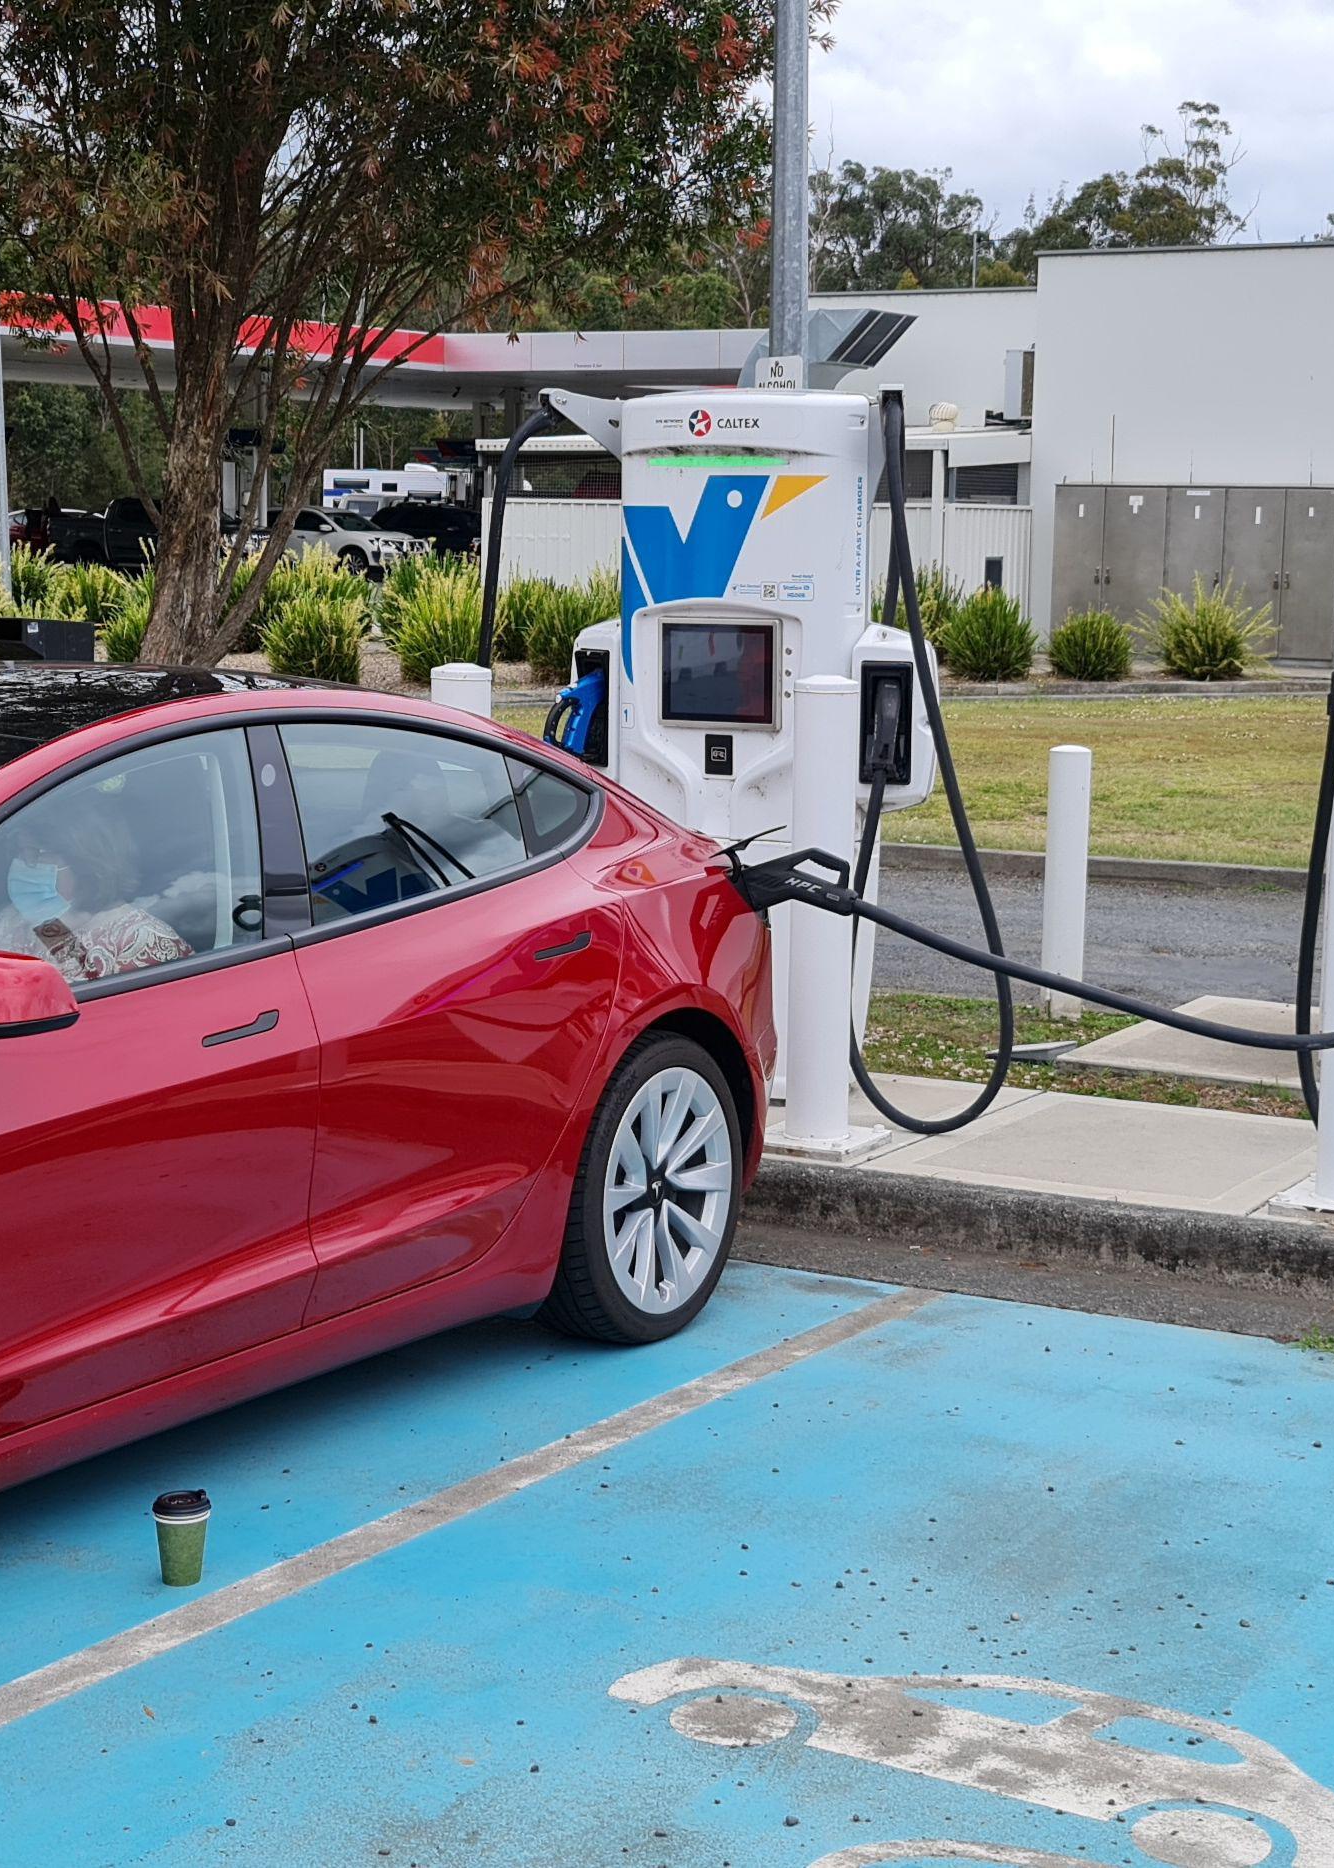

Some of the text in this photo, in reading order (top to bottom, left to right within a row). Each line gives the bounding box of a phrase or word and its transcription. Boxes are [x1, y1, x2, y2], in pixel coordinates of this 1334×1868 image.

[770, 365, 784, 378] NO
[717, 418, 760, 429] CALTEX
[855, 530, 863, 596] ULTRA-FAST
[623, 708, 629, 723] 1
[784, 877, 823, 894] HPC
